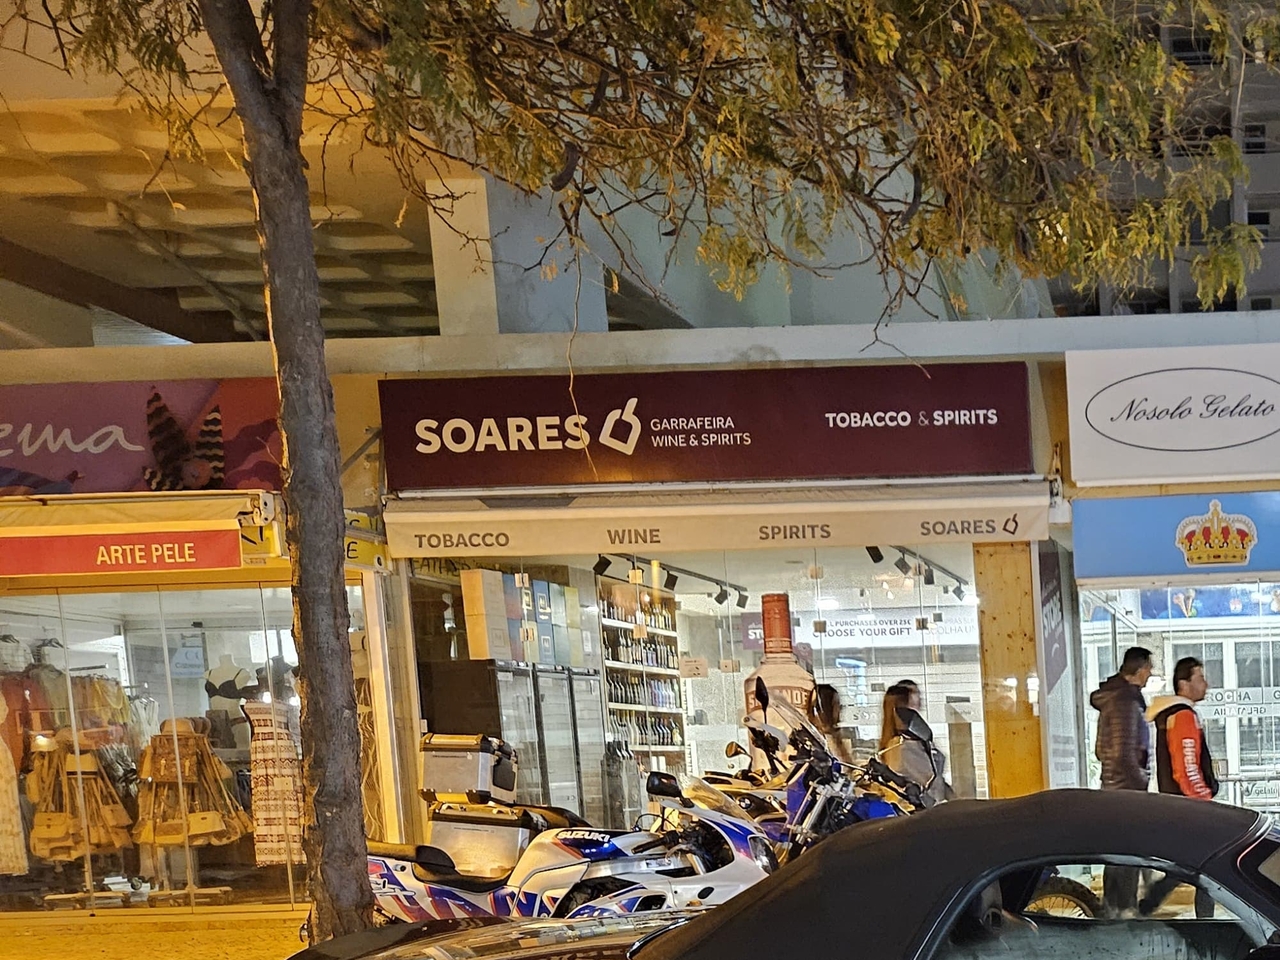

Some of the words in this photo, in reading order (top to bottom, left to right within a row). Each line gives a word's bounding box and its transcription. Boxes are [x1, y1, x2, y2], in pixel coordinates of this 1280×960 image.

[1110, 398, 1194, 424] Nosolo
[1199, 394, 1276, 420] Gelato
[650, 416, 735, 431] GARRAFEIRA
[824, 410, 911, 428] TOBACCO
[917, 410, 930, 426] &
[932, 408, 999, 426] SPIRITS
[415, 415, 588, 454] SOARES
[651, 432, 687, 448] WINE
[688, 432, 699, 446] &
[700, 431, 752, 447] SPIRITS
[758, 523, 832, 540] SPIRITS
[920, 518, 996, 536] SOARES
[414, 532, 510, 548] TOBACCO
[607, 528, 662, 545] WINE
[96, 545, 147, 565] ARTE
[152, 543, 197, 563] PELE
[878, 618, 899, 626] OVER
[859, 628, 887, 637] YOUR
[888, 627, 912, 636] GIFT
[556, 830, 611, 843] SUZUKI
